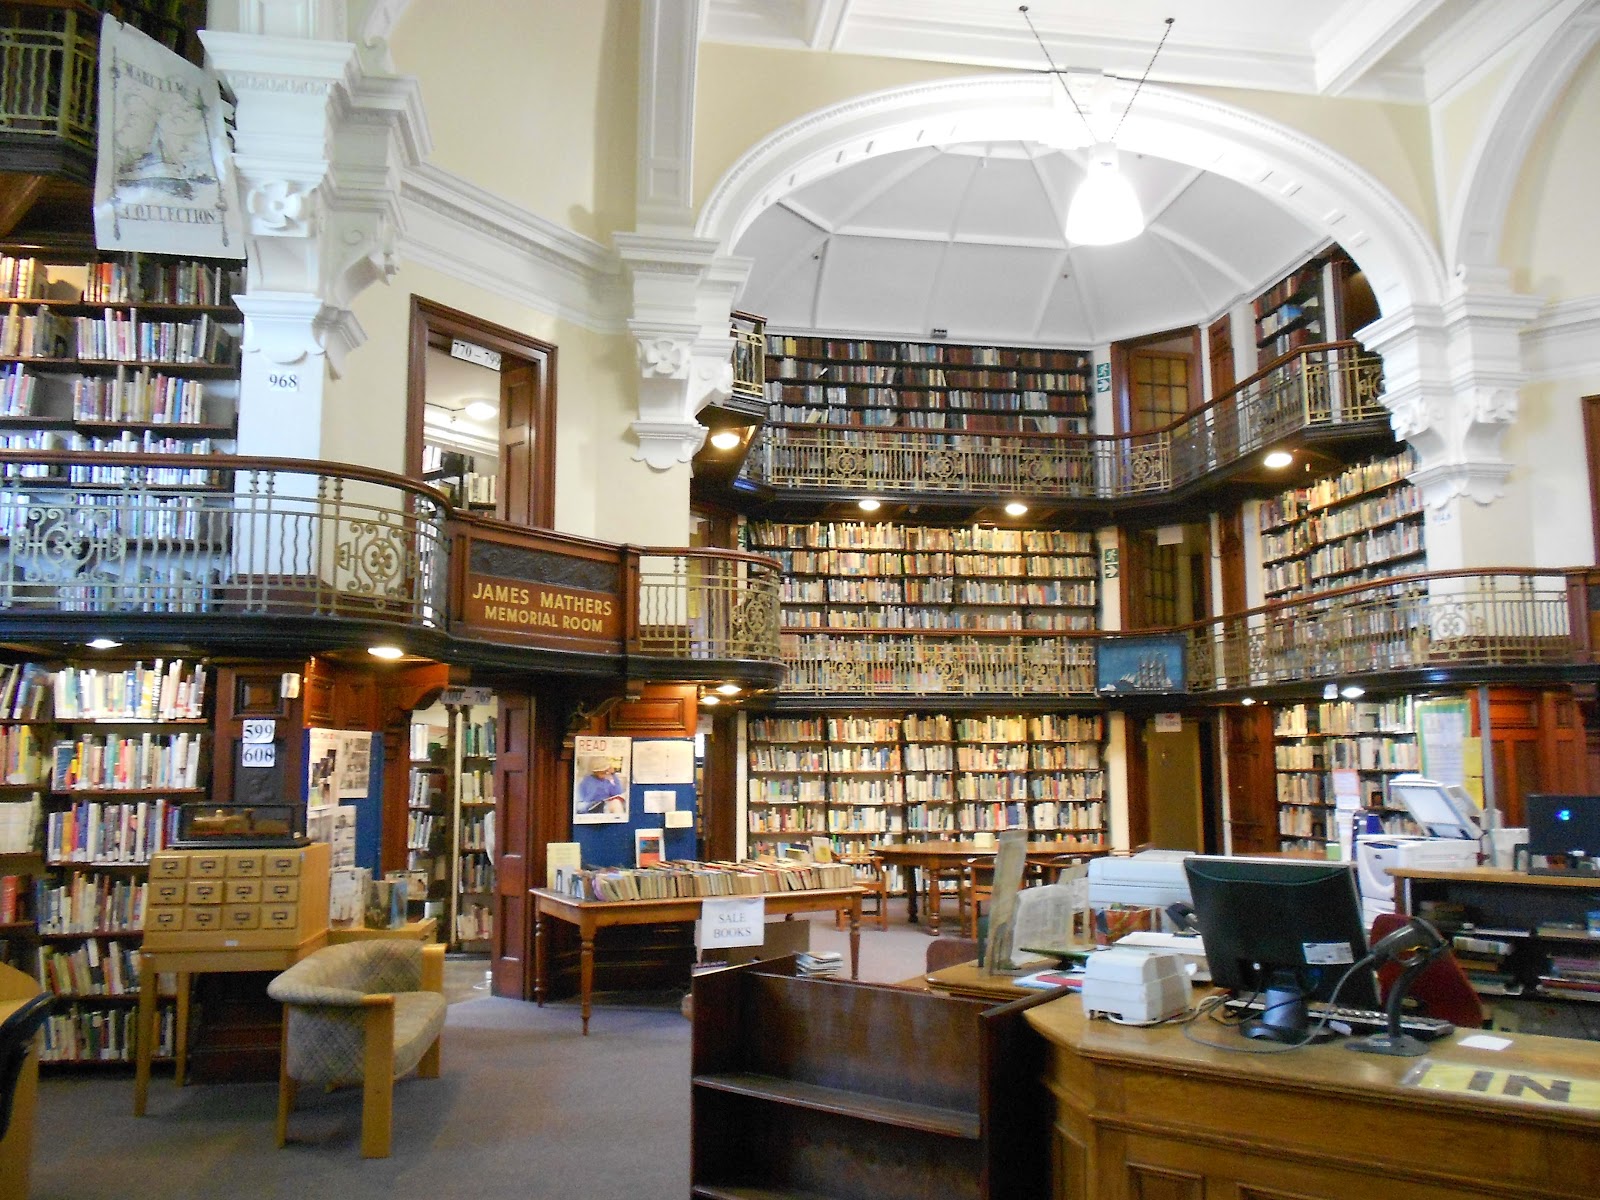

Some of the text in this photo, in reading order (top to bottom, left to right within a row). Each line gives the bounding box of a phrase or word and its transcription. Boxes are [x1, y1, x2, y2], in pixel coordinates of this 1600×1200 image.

[454, 342, 472, 357] 770
[485, 352, 500, 367] 799
[269, 374, 297, 388] 968
[472, 582, 612, 616] JAMES MATHERS
[484, 605, 603, 632] MEMORIAL ROOM
[244, 724, 274, 739] 599
[579, 739, 607, 752] READ
[244, 748, 274, 762] 608
[718, 912, 746, 924] SALE
[713, 927, 752, 939] BOOKS
[1467, 1070, 1572, 1103] IN
